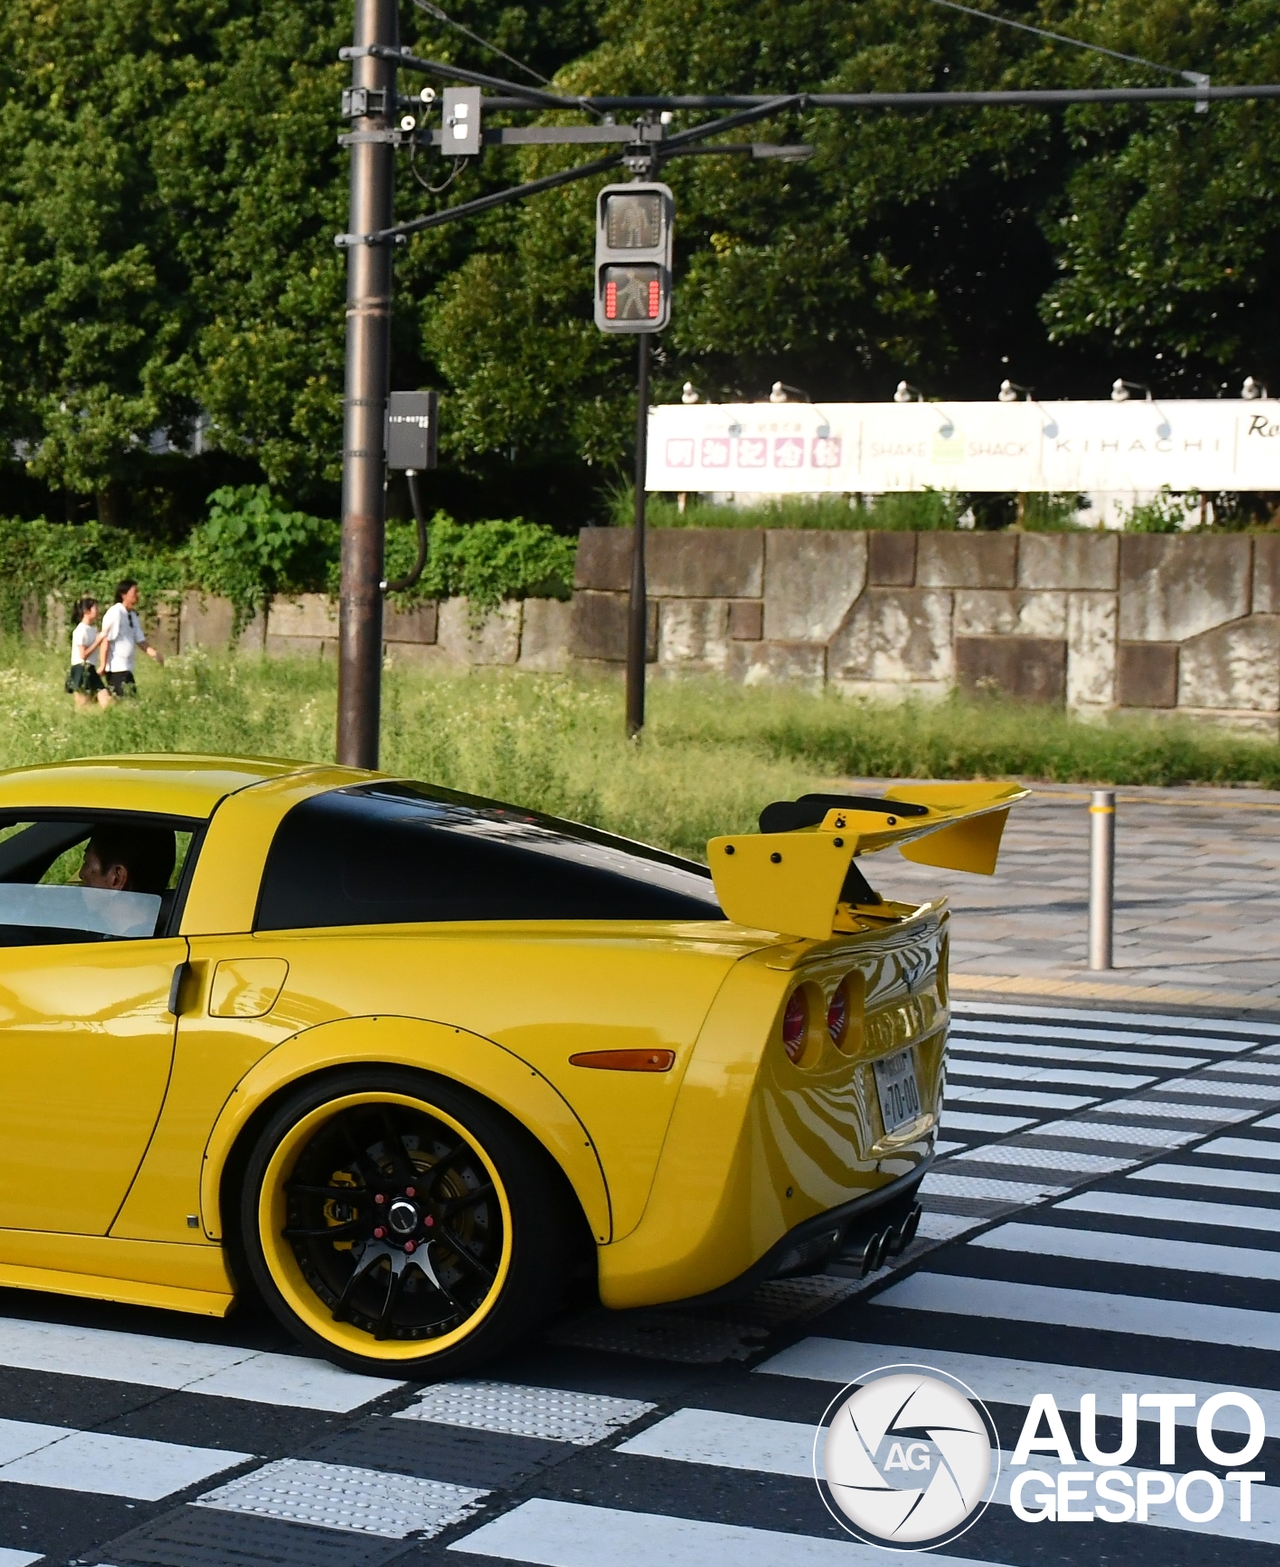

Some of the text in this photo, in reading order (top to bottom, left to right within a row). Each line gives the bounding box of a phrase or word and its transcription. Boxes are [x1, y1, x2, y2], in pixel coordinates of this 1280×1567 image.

[870, 441, 1030, 457] SHAKE SHACK
[1056, 438, 1220, 452] KIHACHI
[886, 1074, 919, 1123] 70-00
